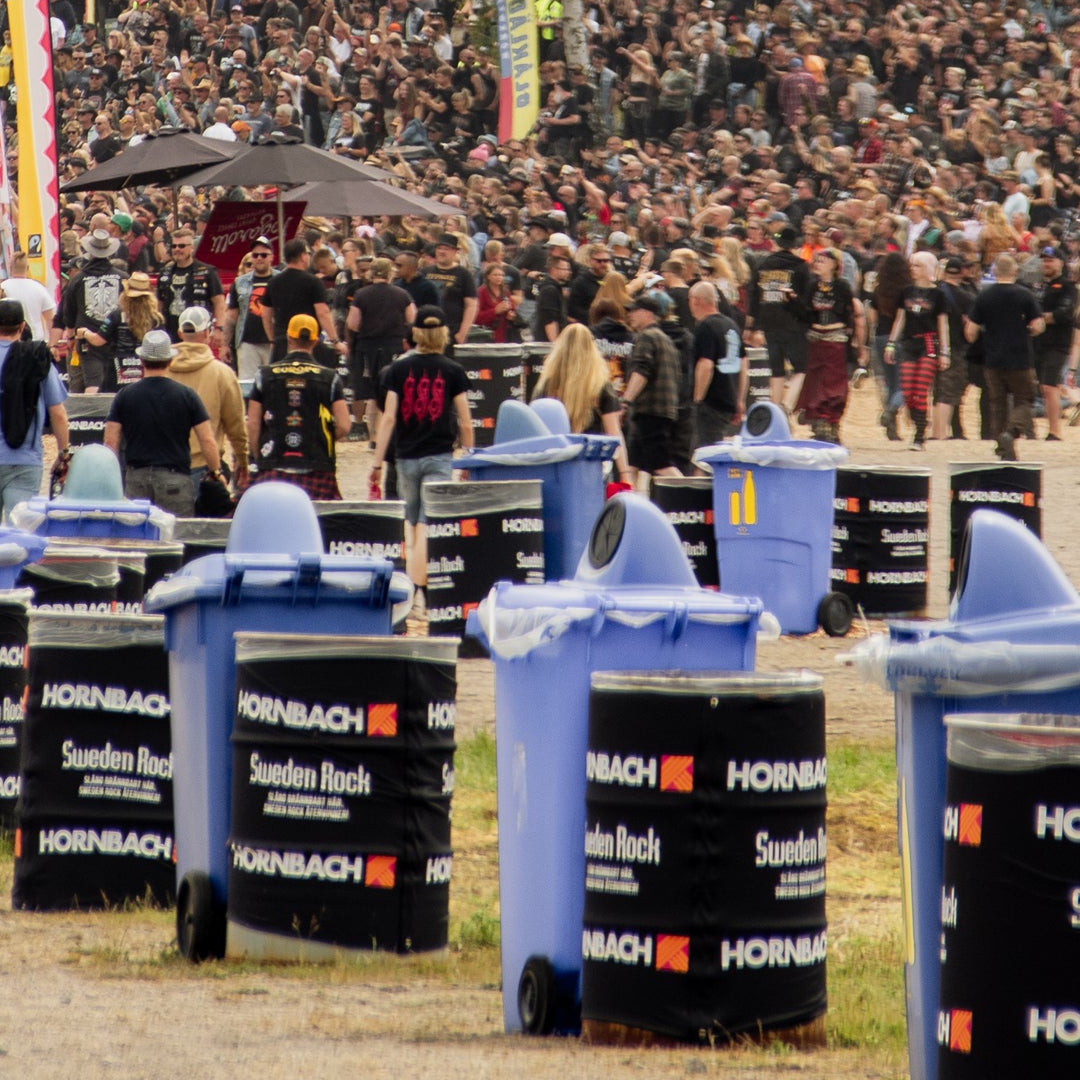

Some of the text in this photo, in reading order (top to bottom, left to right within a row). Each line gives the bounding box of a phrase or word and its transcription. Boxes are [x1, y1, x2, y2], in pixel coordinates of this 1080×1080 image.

[958, 490, 1024, 503] HORNBACH
[41, 683, 171, 719] HORNBACH
[238, 689, 365, 734] HORNBACH
[61, 739, 134, 771] Sweden
[249, 751, 371, 796] Sweden Rock
[38, 829, 172, 860] HORNBACH
[233, 844, 363, 883] HORNBACH
[616, 824, 660, 866] Rock
[755, 828, 818, 868] Sweden
